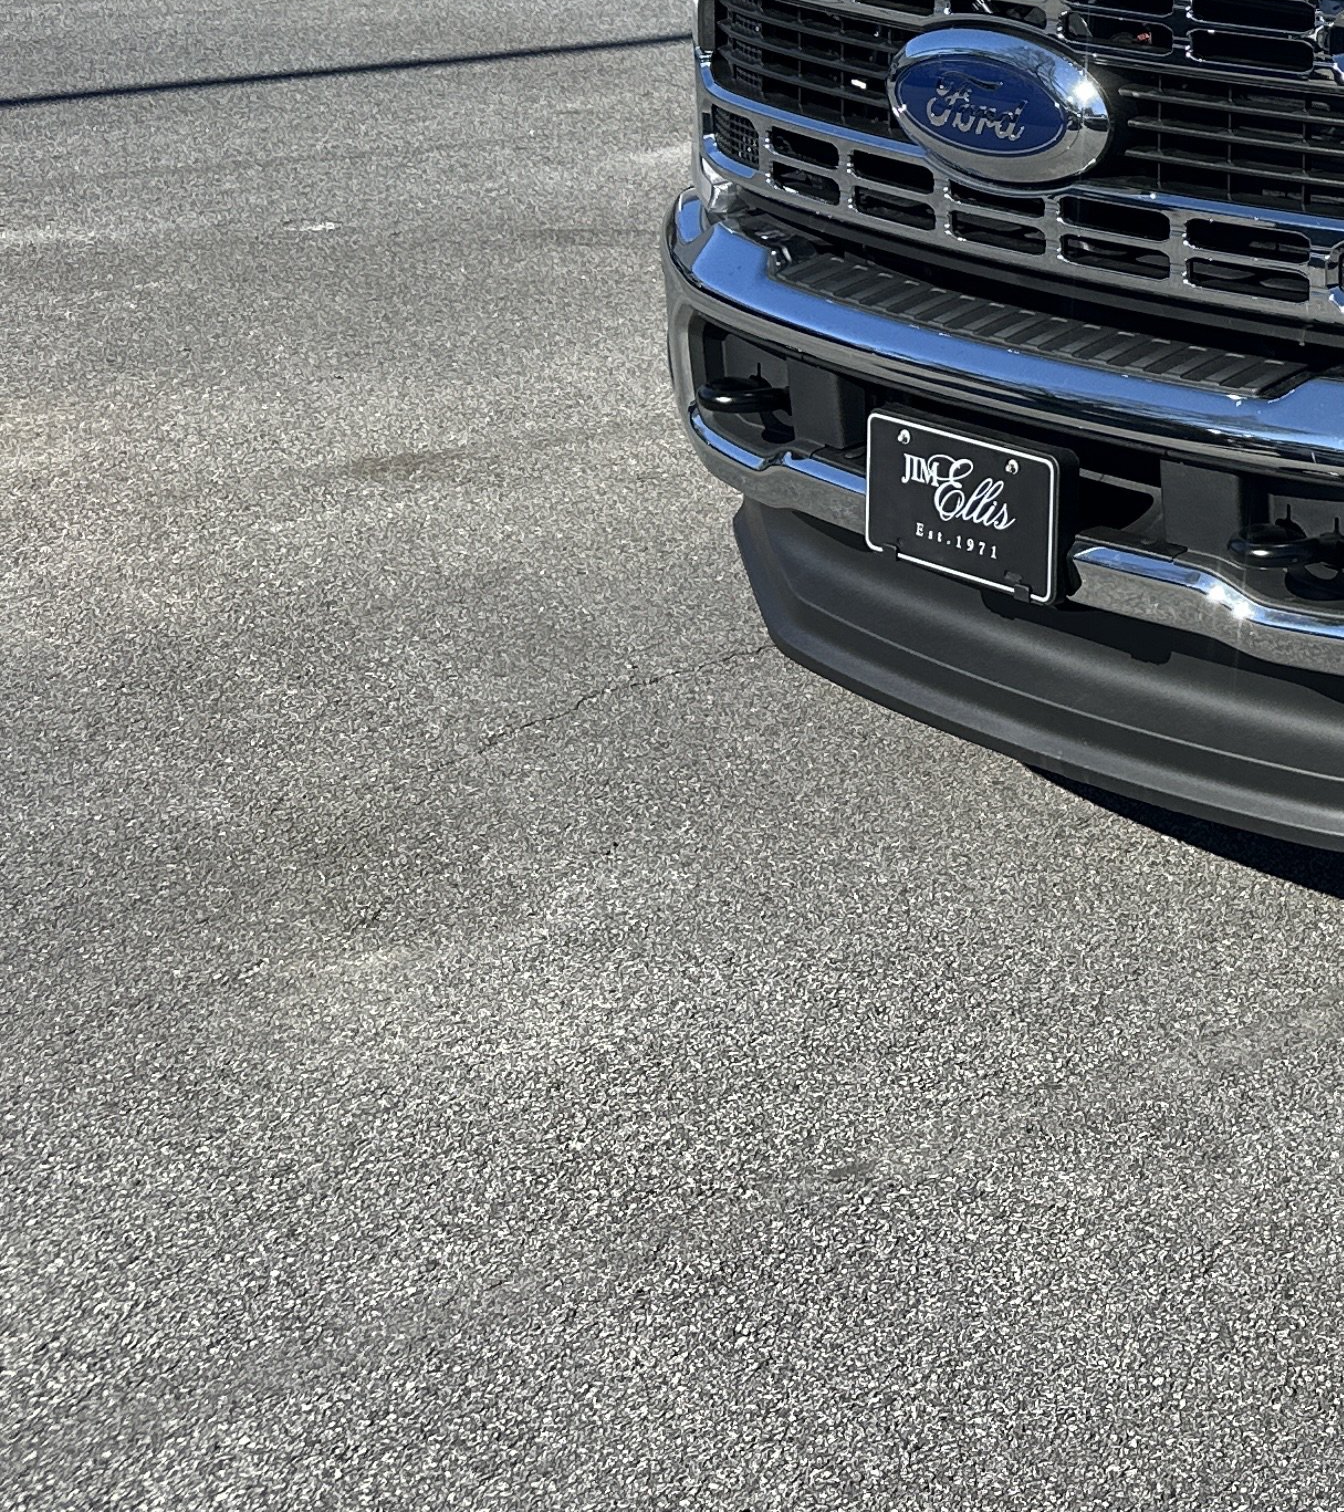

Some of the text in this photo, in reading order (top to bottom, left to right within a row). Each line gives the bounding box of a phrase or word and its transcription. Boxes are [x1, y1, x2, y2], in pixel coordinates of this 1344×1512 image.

[925, 70, 1029, 142] Ford
[901, 452, 1017, 530] JIM Ellis
